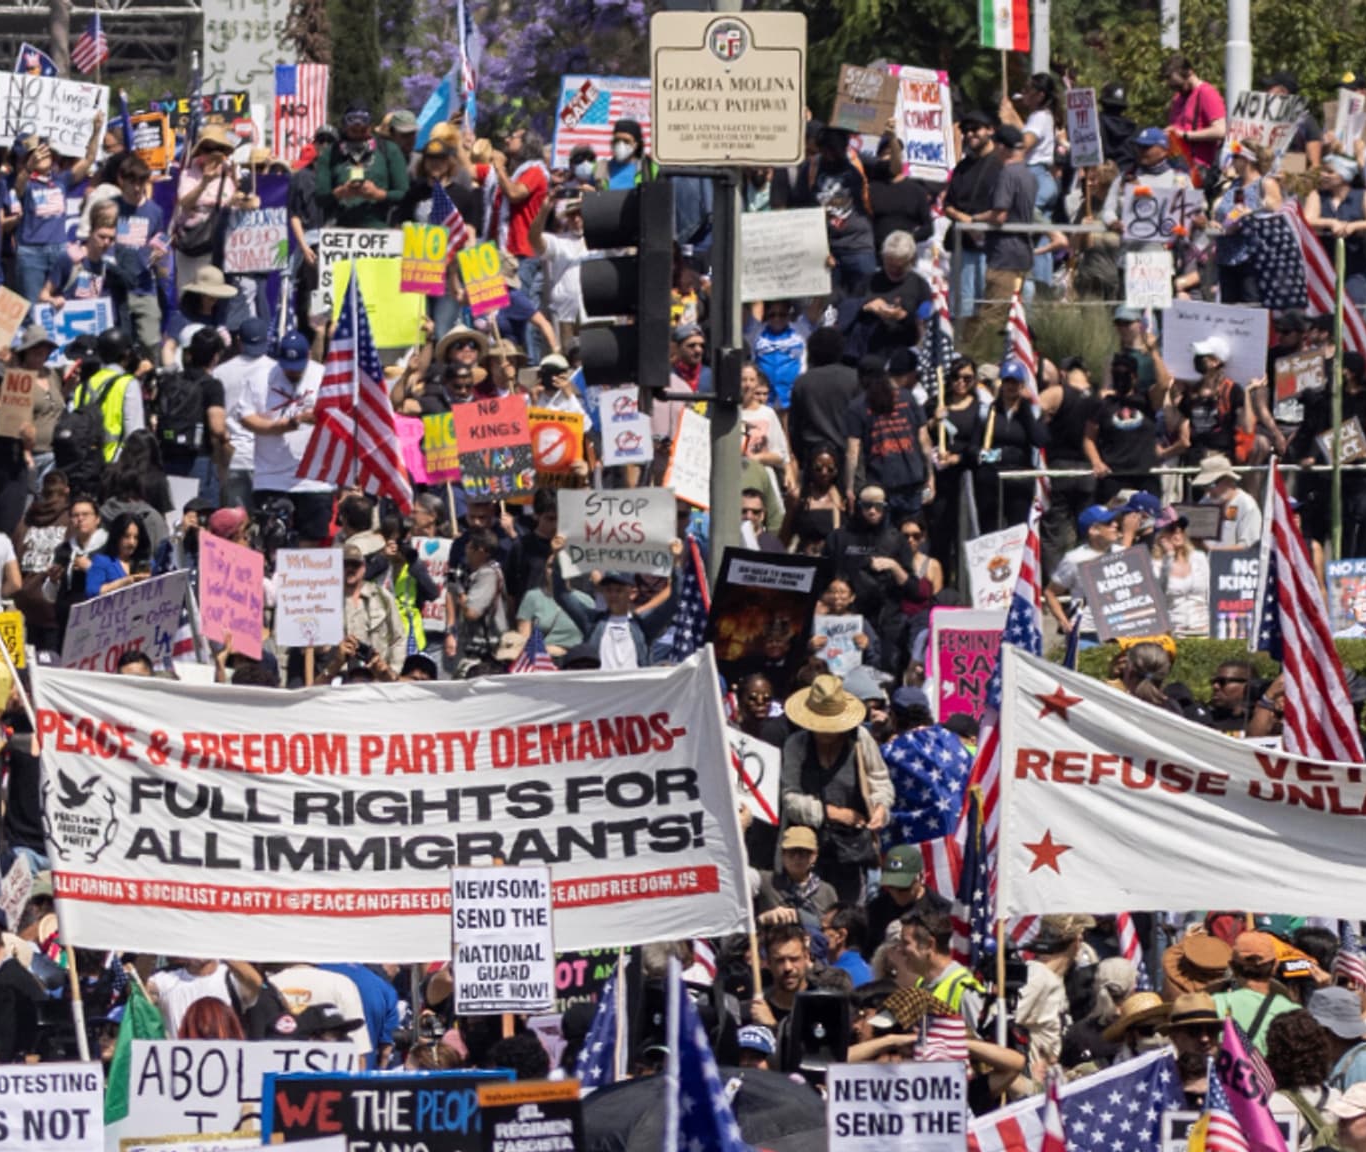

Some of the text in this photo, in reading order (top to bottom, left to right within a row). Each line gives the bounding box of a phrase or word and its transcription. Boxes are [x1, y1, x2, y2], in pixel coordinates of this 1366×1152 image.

[8, 77, 44, 99] NO
[663, 78, 795, 91] GLORIA MOLINA
[667, 98, 787, 112] LEGACY PATHWAY
[45, 126, 87, 147] ICE
[323, 232, 389, 249] GET OFF
[406, 228, 444, 259] NO
[458, 244, 502, 280] NO
[6, 372, 32, 393] NO
[477, 400, 500, 416] NO
[469, 421, 521, 439] KINGS
[586, 492, 649, 516] STOP
[585, 521, 646, 543] MASS
[1102, 561, 1128, 579] NO
[1329, 564, 1352, 576] NO
[1097, 571, 1144, 594] KINGS
[1102, 595, 1154, 615] AMERICA
[36, 708, 481, 778] PEACE & FREEDOM PARTY
[1015, 748, 1231, 797] REFUSE
[130, 768, 699, 828] FULL RIGHTS FOR
[124, 828, 243, 872] ALL
[143, 883, 275, 908] SOCIALIST PARTY
[455, 878, 547, 902] NEWSOM:
[456, 907, 549, 929] SEND THE
[457, 945, 547, 965] NATIONAL
[477, 964, 531, 982] GUARD
[460, 981, 549, 1001] HOME NOW!
[835, 1076, 962, 1102] NEWSOM:
[277, 1090, 412, 1132] WE THE
[23, 1108, 91, 1142] NOT
[836, 1110, 961, 1137] SEND THE
